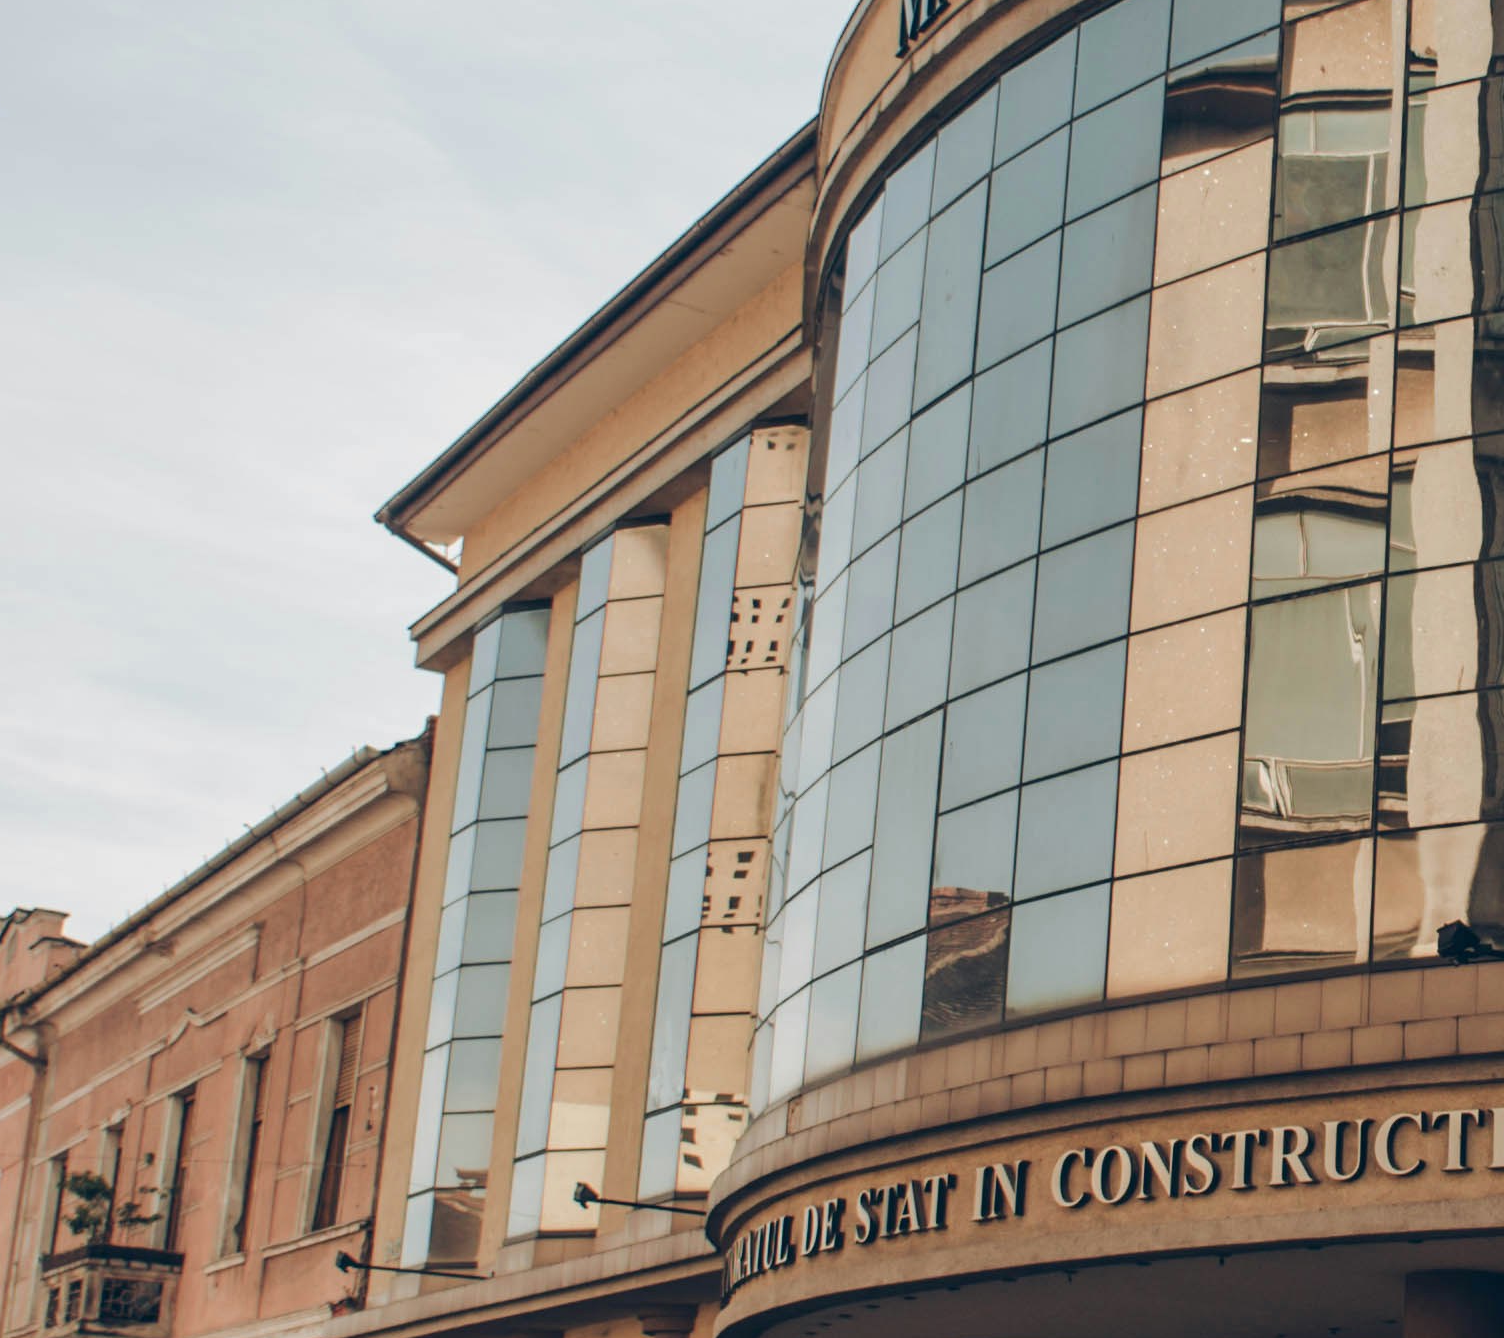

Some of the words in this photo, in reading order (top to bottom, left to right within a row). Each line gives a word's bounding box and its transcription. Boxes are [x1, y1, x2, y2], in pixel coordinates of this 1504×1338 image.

[800, 1198, 843, 1257] DE
[854, 1173, 954, 1245] STAT
[972, 1160, 1029, 1223] IN
